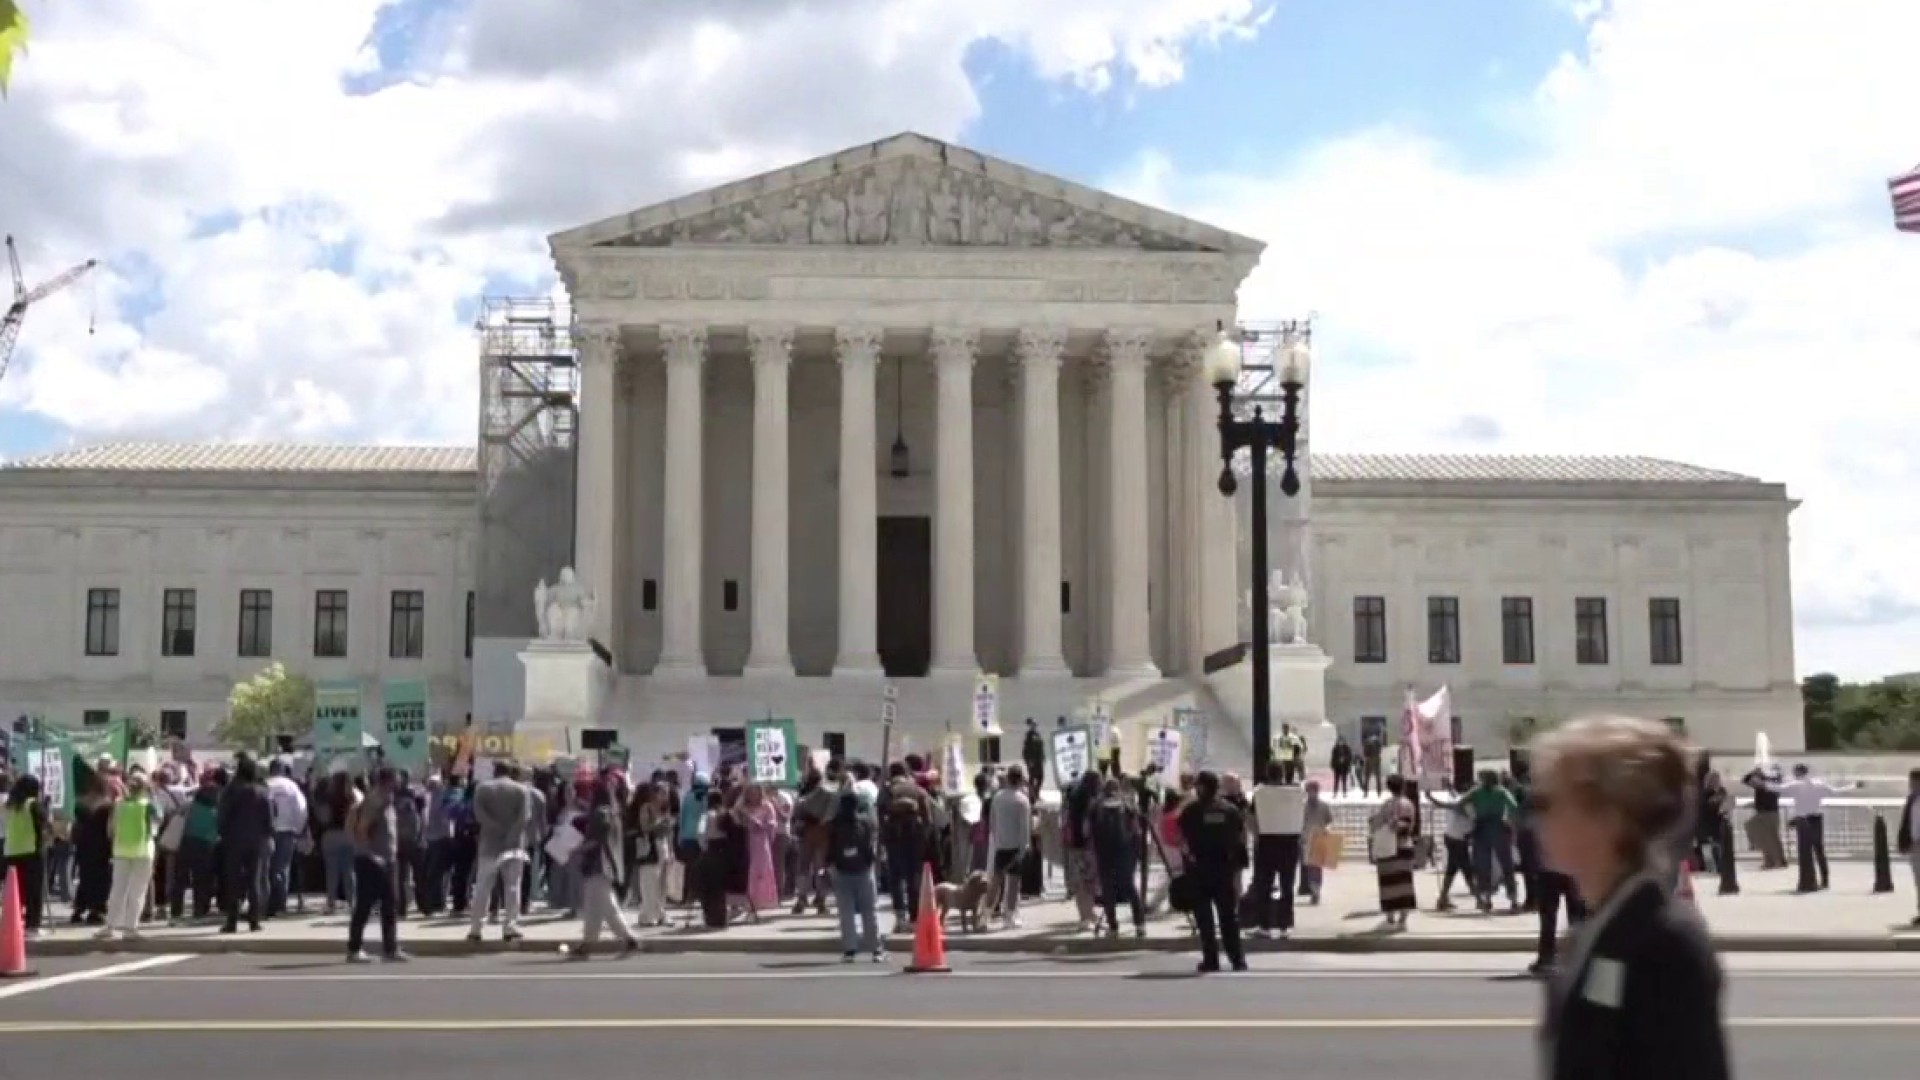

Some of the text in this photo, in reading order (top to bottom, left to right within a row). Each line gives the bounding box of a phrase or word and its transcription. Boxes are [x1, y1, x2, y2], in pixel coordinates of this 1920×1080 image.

[316, 706, 359, 718] LIVES
[386, 710, 425, 719] SAVES
[386, 720, 425, 732] LIVES
